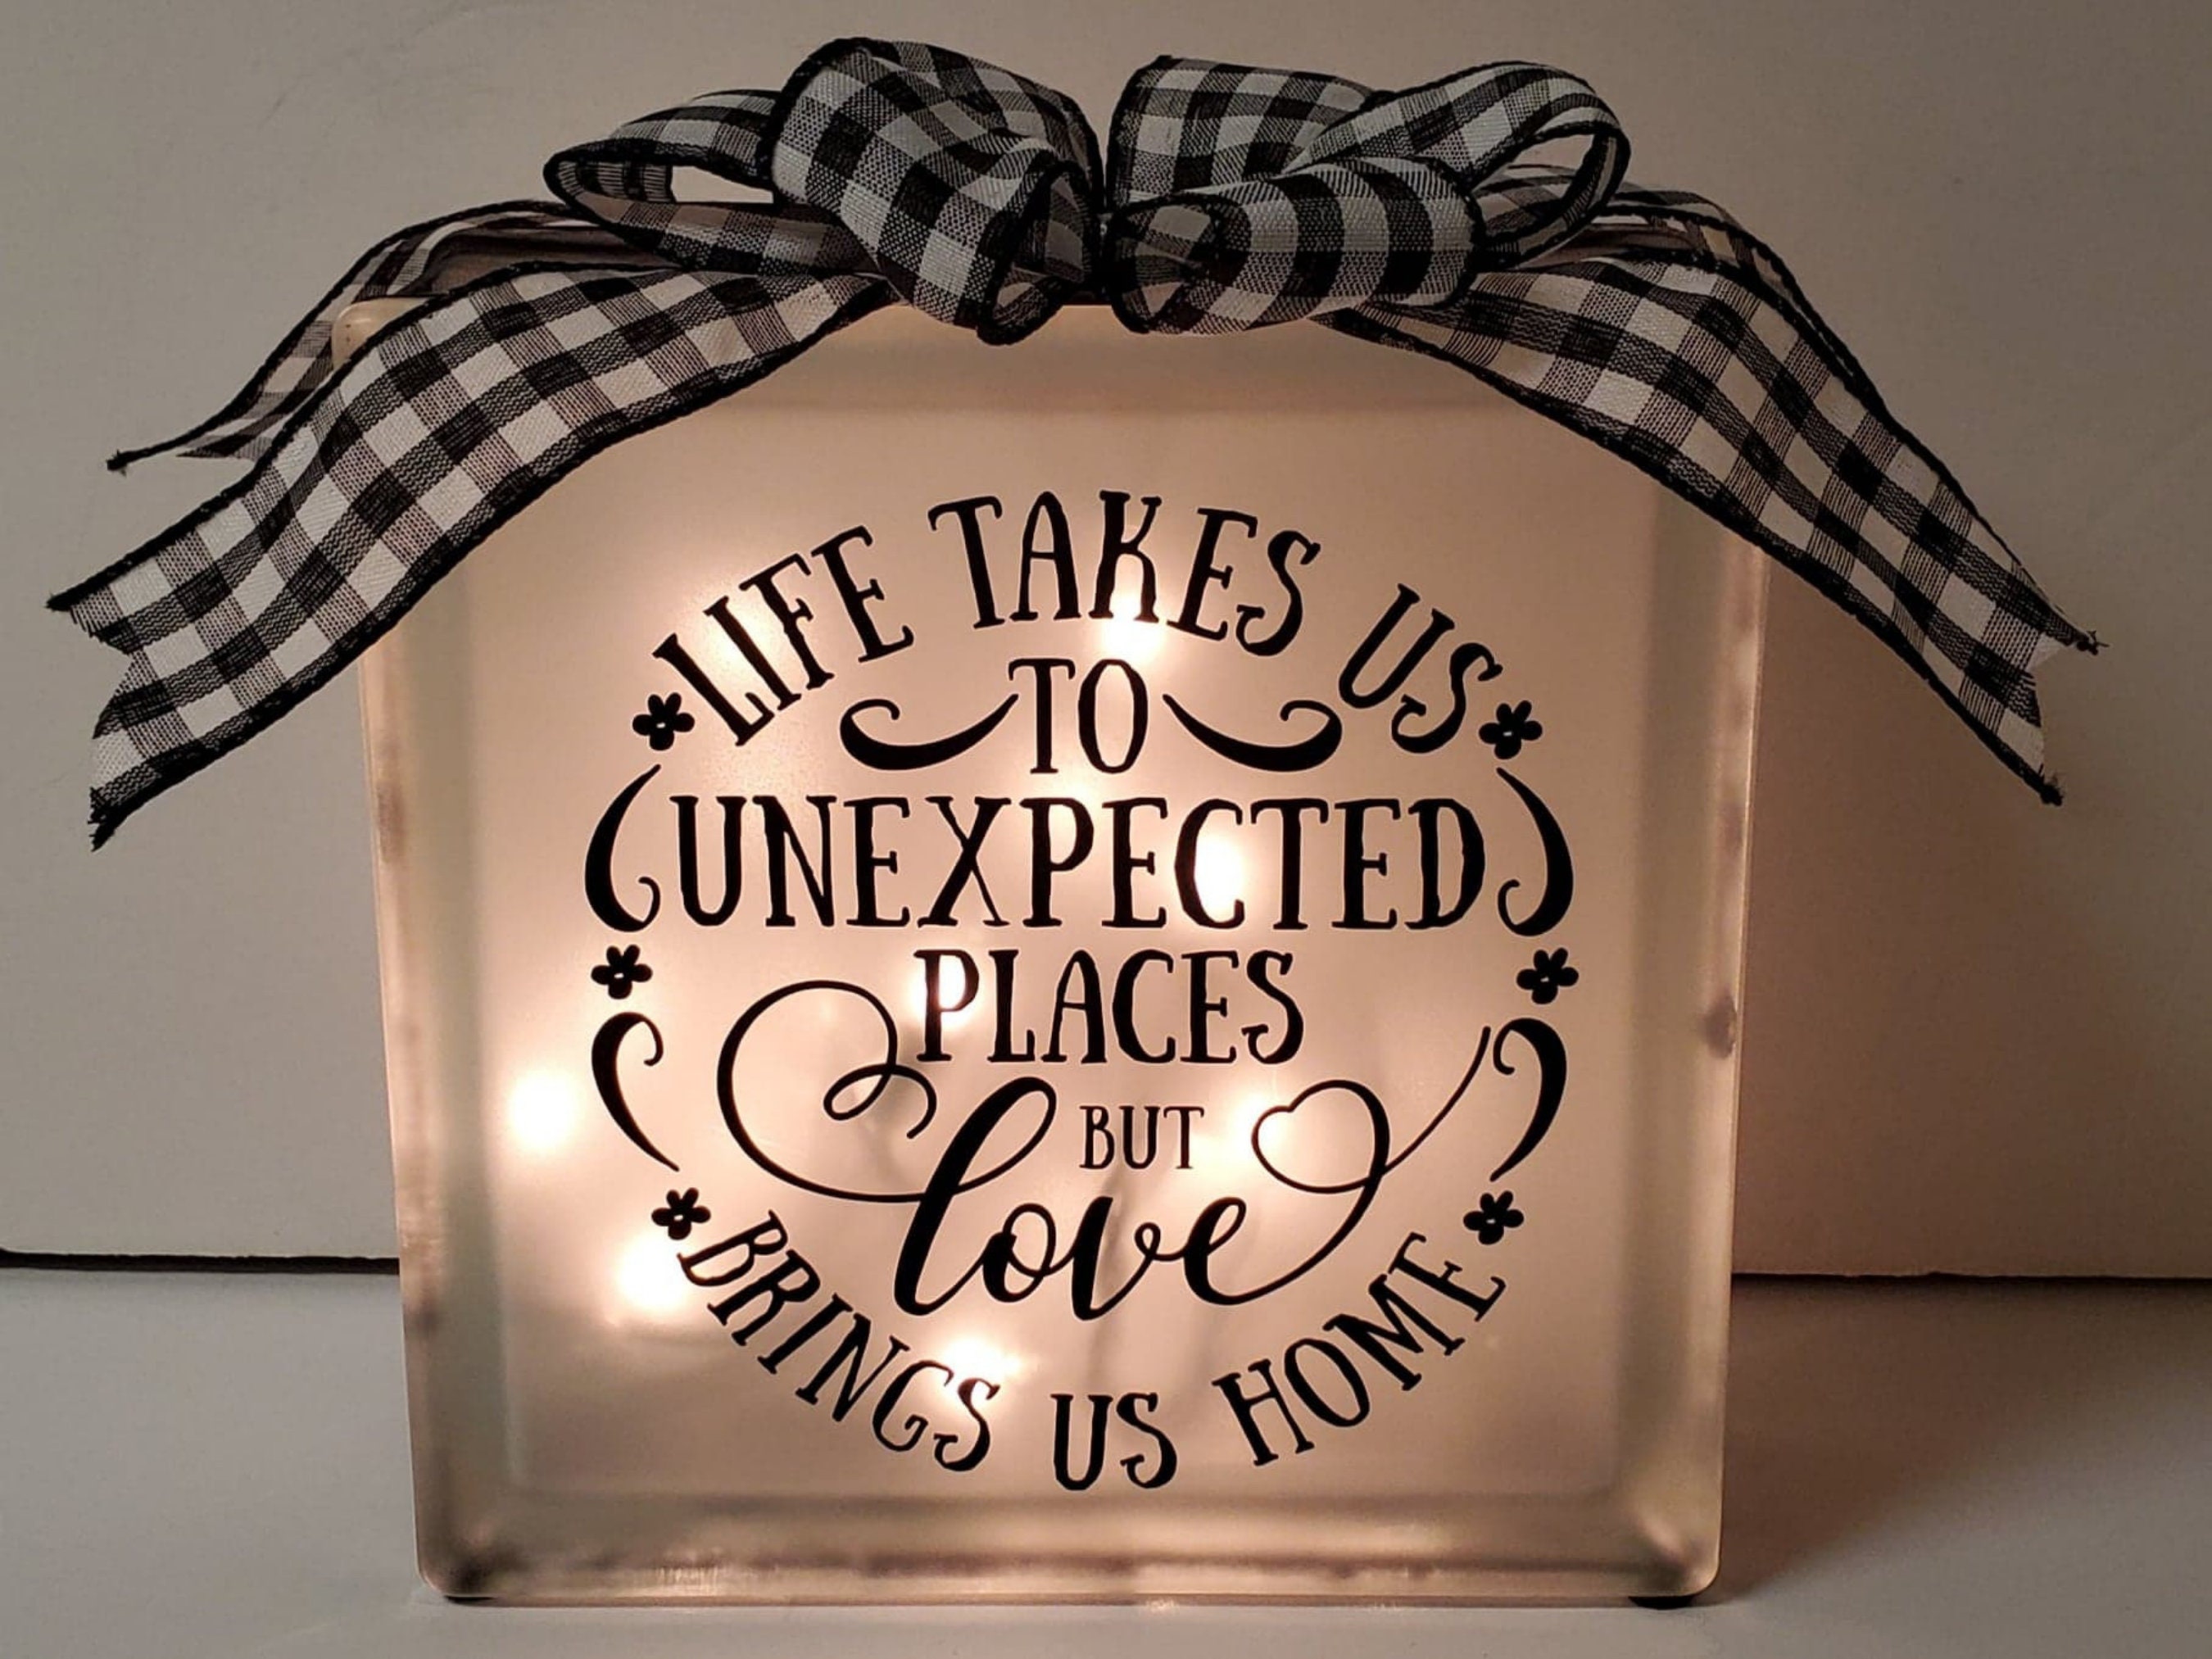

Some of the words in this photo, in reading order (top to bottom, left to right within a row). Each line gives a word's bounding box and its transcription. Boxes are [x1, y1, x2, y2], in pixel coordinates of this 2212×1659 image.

[651, 525, 915, 747] LIFE
[927, 489, 1321, 657] TAKES
[1337, 582, 1504, 755] US
[1008, 658, 1149, 774] TO
[669, 795, 1485, 931] UNEXPECTED
[913, 949, 1304, 1064] PLACES
[881, 1074, 1413, 1321] love
[1079, 1105, 1205, 1171] BUT
[677, 1209, 1001, 1474] BRINGS
[1049, 1393, 1178, 1491] US
[1211, 1231, 1507, 1467] HOME
